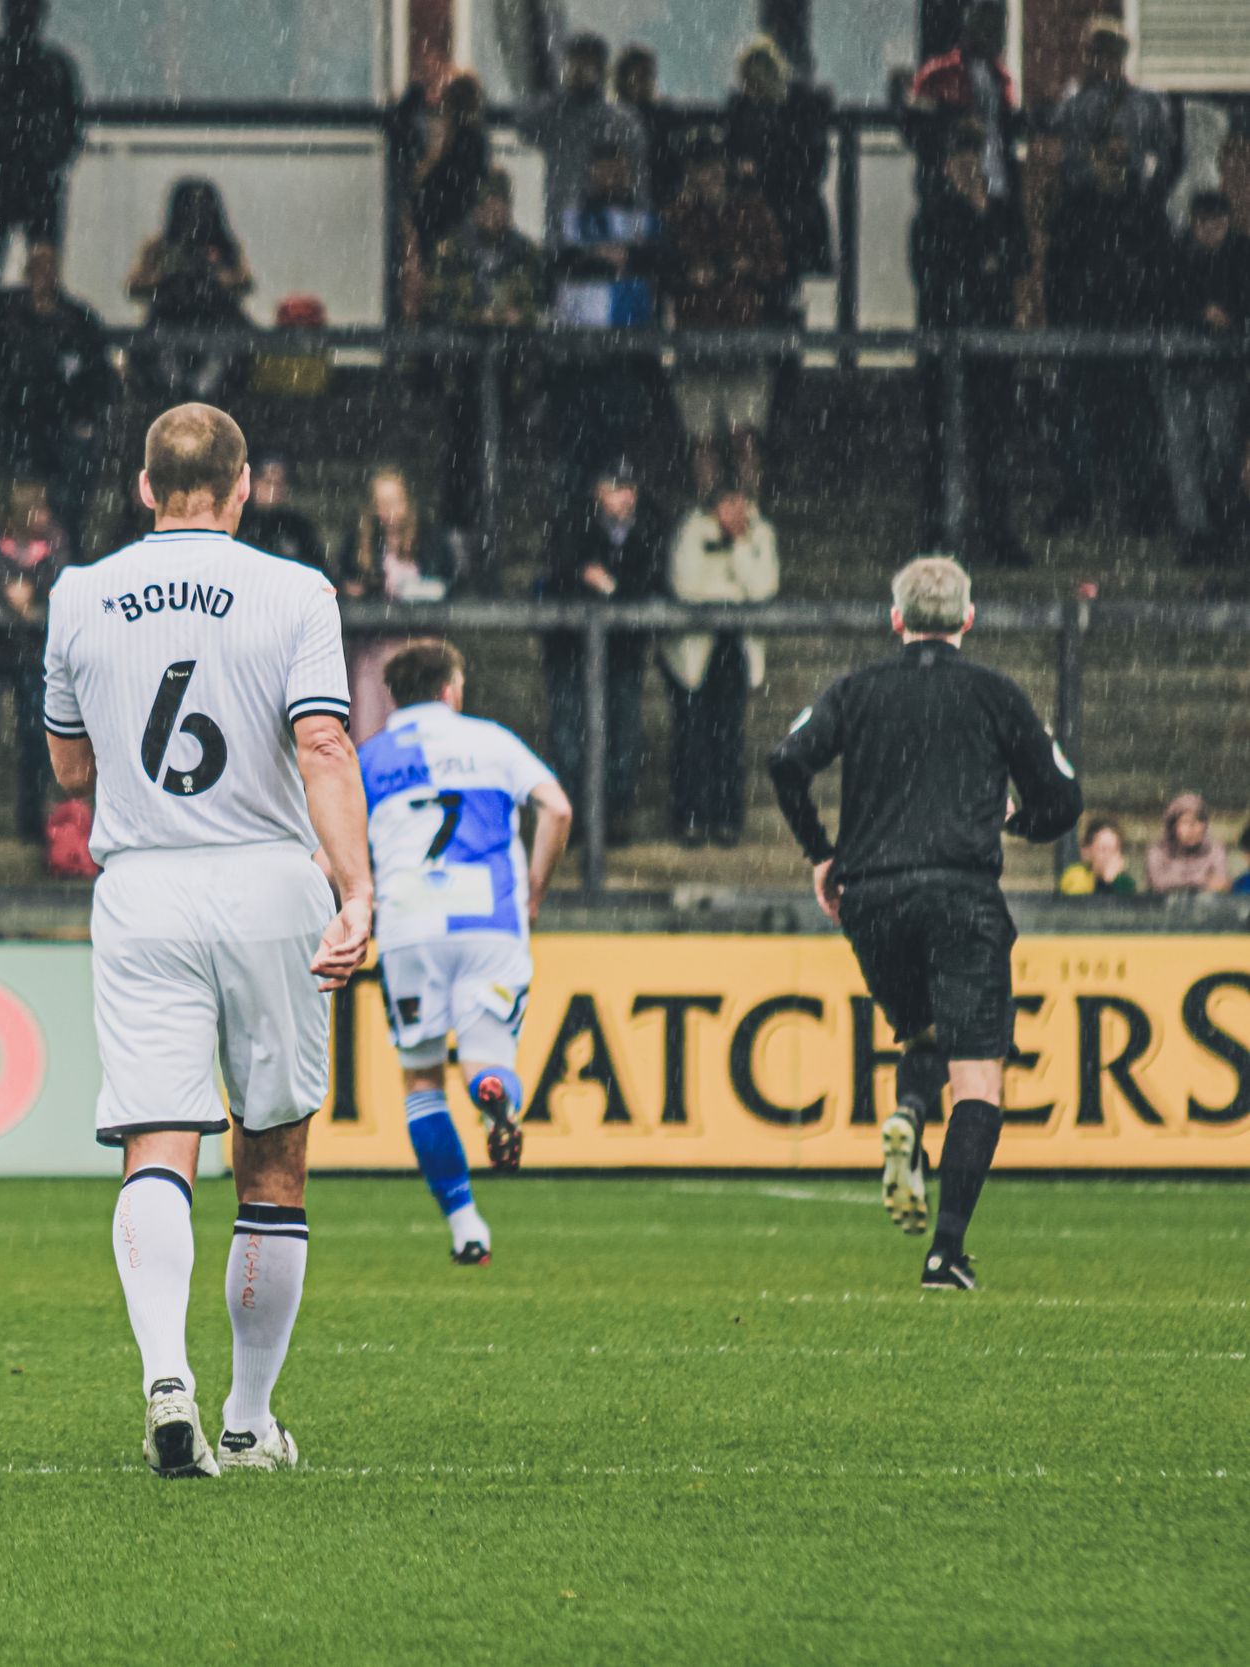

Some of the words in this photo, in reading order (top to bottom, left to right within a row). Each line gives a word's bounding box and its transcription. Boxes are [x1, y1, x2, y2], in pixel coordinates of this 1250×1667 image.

[117, 582, 235, 622] BOUND
[140, 660, 228, 796] 6
[408, 791, 464, 863] 7
[328, 966, 1250, 1128] TATCHERS
